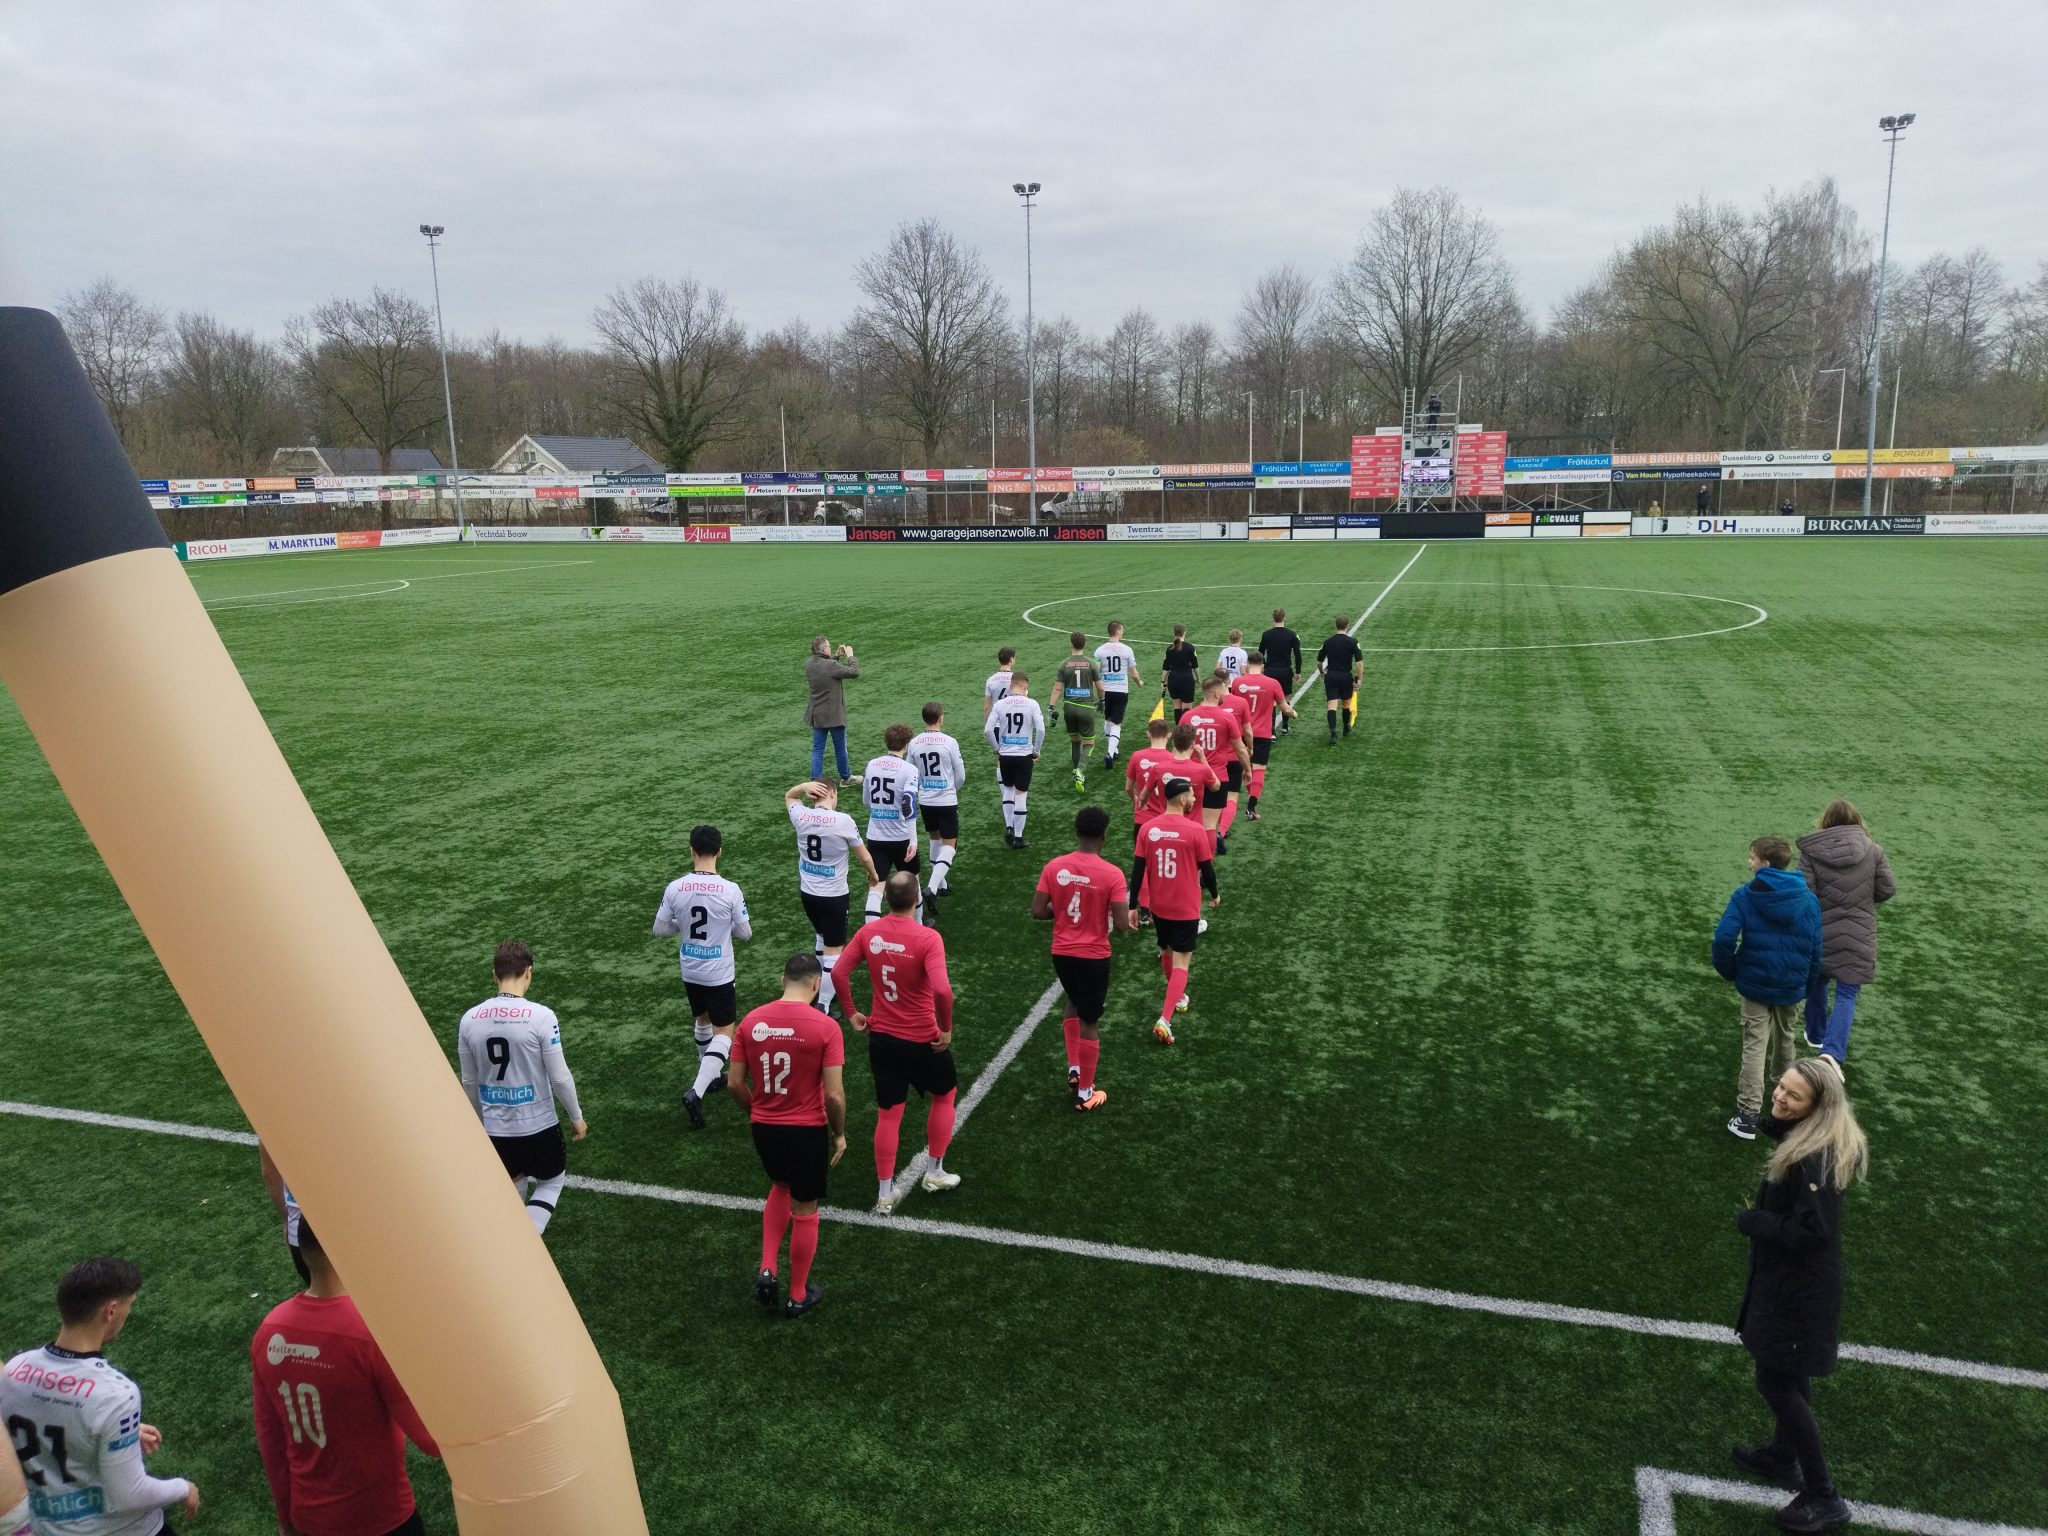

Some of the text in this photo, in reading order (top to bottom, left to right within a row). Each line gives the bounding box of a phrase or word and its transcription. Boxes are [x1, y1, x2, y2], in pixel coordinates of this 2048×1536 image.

[1722, 454, 1762, 462] Dusseldorp
[1778, 453, 1819, 461] Dusseldorp
[1893, 450, 1934, 458] BORGER
[1567, 458, 1609, 466] Fröhlich.nl
[1529, 472, 1611, 480] www.totaalsupport.eu
[1842, 468, 1868, 477] ING
[1899, 468, 1927, 477] ING
[316, 478, 343, 488] POUW
[993, 484, 1013, 492] ING
[1036, 484, 1055, 492] ING
[1698, 520, 1736, 533] DLH
[1808, 519, 1892, 531] BURGMAN
[474, 530, 528, 538] Vechtdal Bouw
[686, 527, 726, 542] Aldura
[848, 527, 896, 540] Jansen
[902, 526, 1048, 540] www.garagejansenzwolle.nl
[1054, 526, 1105, 540] Jansen
[282, 536, 336, 549] MARKTLINK
[188, 544, 227, 556] RICOH
[1106, 656, 1121, 672] 10
[1225, 655, 1237, 670] 12
[1074, 670, 1080, 688] 1
[1250, 694, 1258, 712] 7
[1006, 712, 1024, 734] 19
[915, 736, 946, 744] Jansen
[1196, 728, 1216, 751] 30
[872, 760, 902, 769] Jansen
[920, 752, 941, 776] 12
[870, 776, 896, 805] 25
[800, 812, 836, 824] Jansen
[806, 834, 822, 862] 8
[804, 863, 836, 875] Fröhlich
[1156, 848, 1177, 879] 16
[677, 881, 724, 893] Jansen
[1067, 891, 1082, 924] 4
[690, 905, 708, 940] 2
[685, 944, 720, 956] Fröhlich
[881, 964, 898, 1002] 5
[472, 1006, 532, 1020] Jansen
[486, 1036, 510, 1081] 9
[759, 1051, 791, 1095] 12
[488, 1086, 532, 1100] Fröhlich
[8, 1356, 96, 1398] Jansen
[277, 1380, 327, 1449] 10
[8, 1414, 78, 1486] 21
